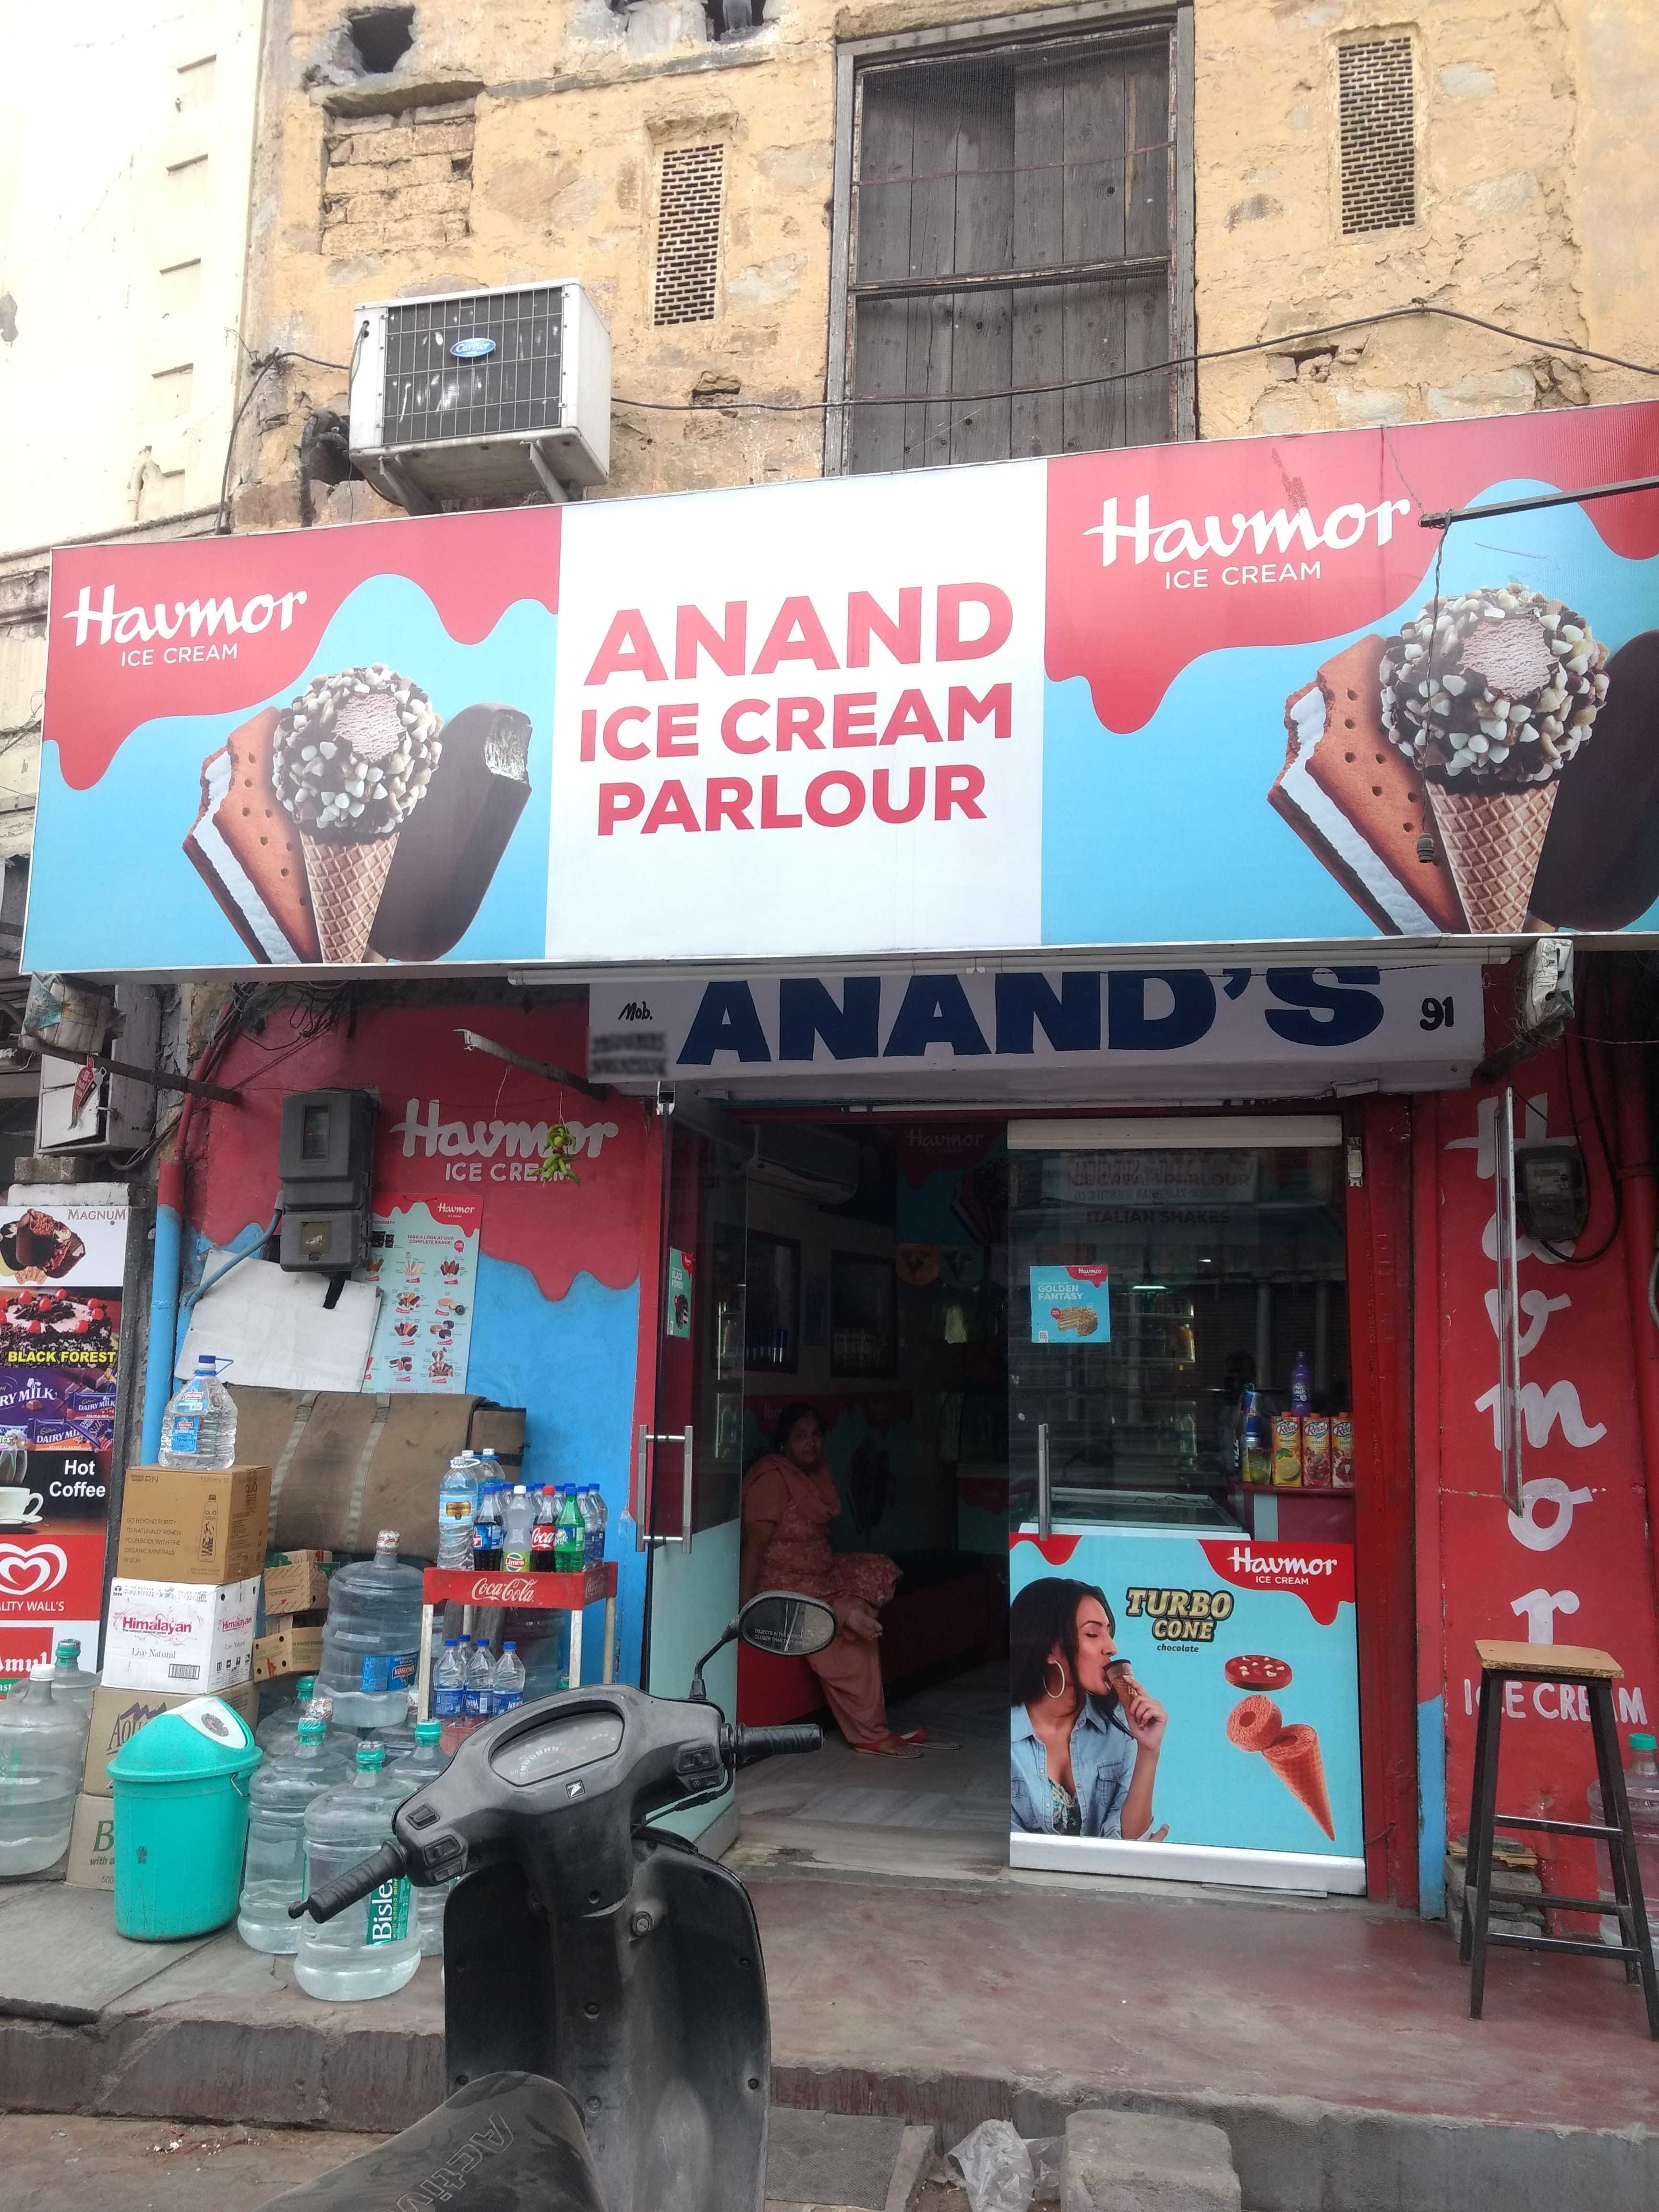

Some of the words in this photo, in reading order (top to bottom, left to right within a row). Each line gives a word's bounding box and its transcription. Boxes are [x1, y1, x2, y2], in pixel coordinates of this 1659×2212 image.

[455, 341, 490, 353] Carrier
[1082, 494, 1411, 567] Havmor
[1166, 569, 1209, 590] ICE
[1221, 561, 1322, 586] CREAM
[62, 584, 307, 647] Havmor
[584, 582, 1013, 686] ANAND
[121, 649, 155, 668] ICE
[163, 642, 238, 665] CREAM
[580, 703, 699, 762] ICE
[720, 683, 1012, 755] CREAM
[597, 764, 987, 836] PARLOUR
[618, 1000, 653, 1022] Mob.
[676, 966, 1385, 1065] ANAND'S
[1419, 996, 1454, 1031] 91
[445, 1162, 482, 1182] ICE
[490, 1163, 572, 1181] CREM
[67, 1209, 126, 1221] MAGNUM
[438, 1202, 475, 1214] Havmor
[1086, 1211, 1154, 1225] ITALIAN
[1159, 1210, 1230, 1224] SHAKES
[1038, 1285, 1079, 1293] GOLDEN
[1038, 1292, 1083, 1301] FANTASY
[8, 1351, 57, 1363] BLACK
[60, 1351, 117, 1363] FOREST
[19, 1386, 58, 1402] MILK
[78, 1402, 99, 1411] DAIRY
[1307, 1422, 1326, 1435] Real
[36, 1433, 64, 1444] DAIRY
[64, 1459, 96, 1475] Hot
[48, 1481, 107, 1498] Coffee
[1227, 1547, 1338, 1576] Havmor
[1255, 1576, 1273, 1585] ICE
[1274, 1576, 1309, 1585] CREAM
[471, 1577, 539, 1603] Coca-Cola
[0, 1601, 24, 1611] LITY
[26, 1600, 65, 1612] WALL'S
[1126, 1587, 1234, 1620] TURBO
[122, 1615, 192, 1635] Himalayan
[222, 1616, 252, 1630] Himalayan
[1152, 1618, 1215, 1642] CONE
[754, 1628, 773, 1636] OBJECTS
[132, 1647, 148, 1657] Live
[148, 1648, 176, 1659] Natural
[1156, 1643, 1200, 1653] chocolate
[1464, 1678, 1527, 1719] IE
[1532, 1682, 1648, 1726] CREM
[90, 1855, 108, 1865] with
[372, 1878, 394, 1940] Bisle
[381, 2114, 514, 2212] Activ
